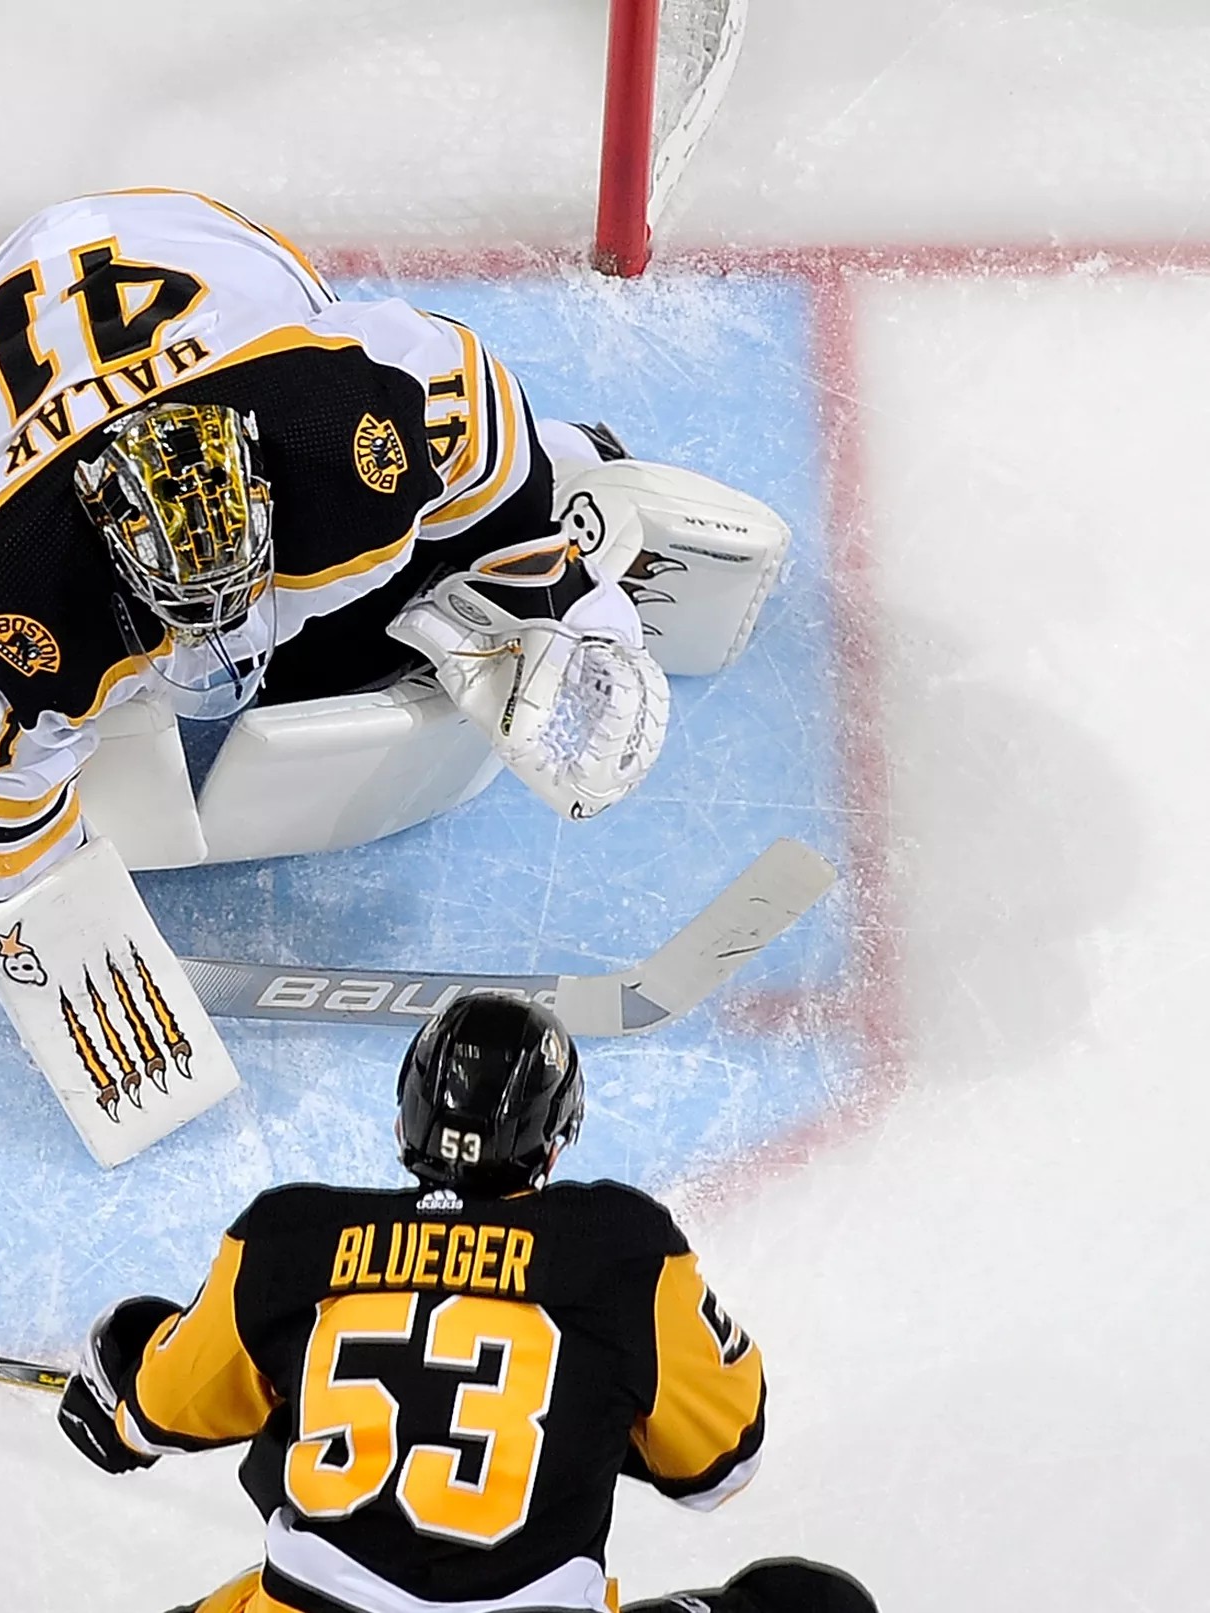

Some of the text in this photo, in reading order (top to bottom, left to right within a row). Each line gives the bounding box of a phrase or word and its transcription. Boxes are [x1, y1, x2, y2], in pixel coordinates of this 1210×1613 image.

[4, 336, 210, 476] HALAK
[425, 369, 470, 471] 41
[356, 416, 395, 490] BOSTON
[440, 1127, 482, 1163] 53
[330, 1221, 535, 1296] BLUEGER
[284, 1291, 562, 1550] 53
